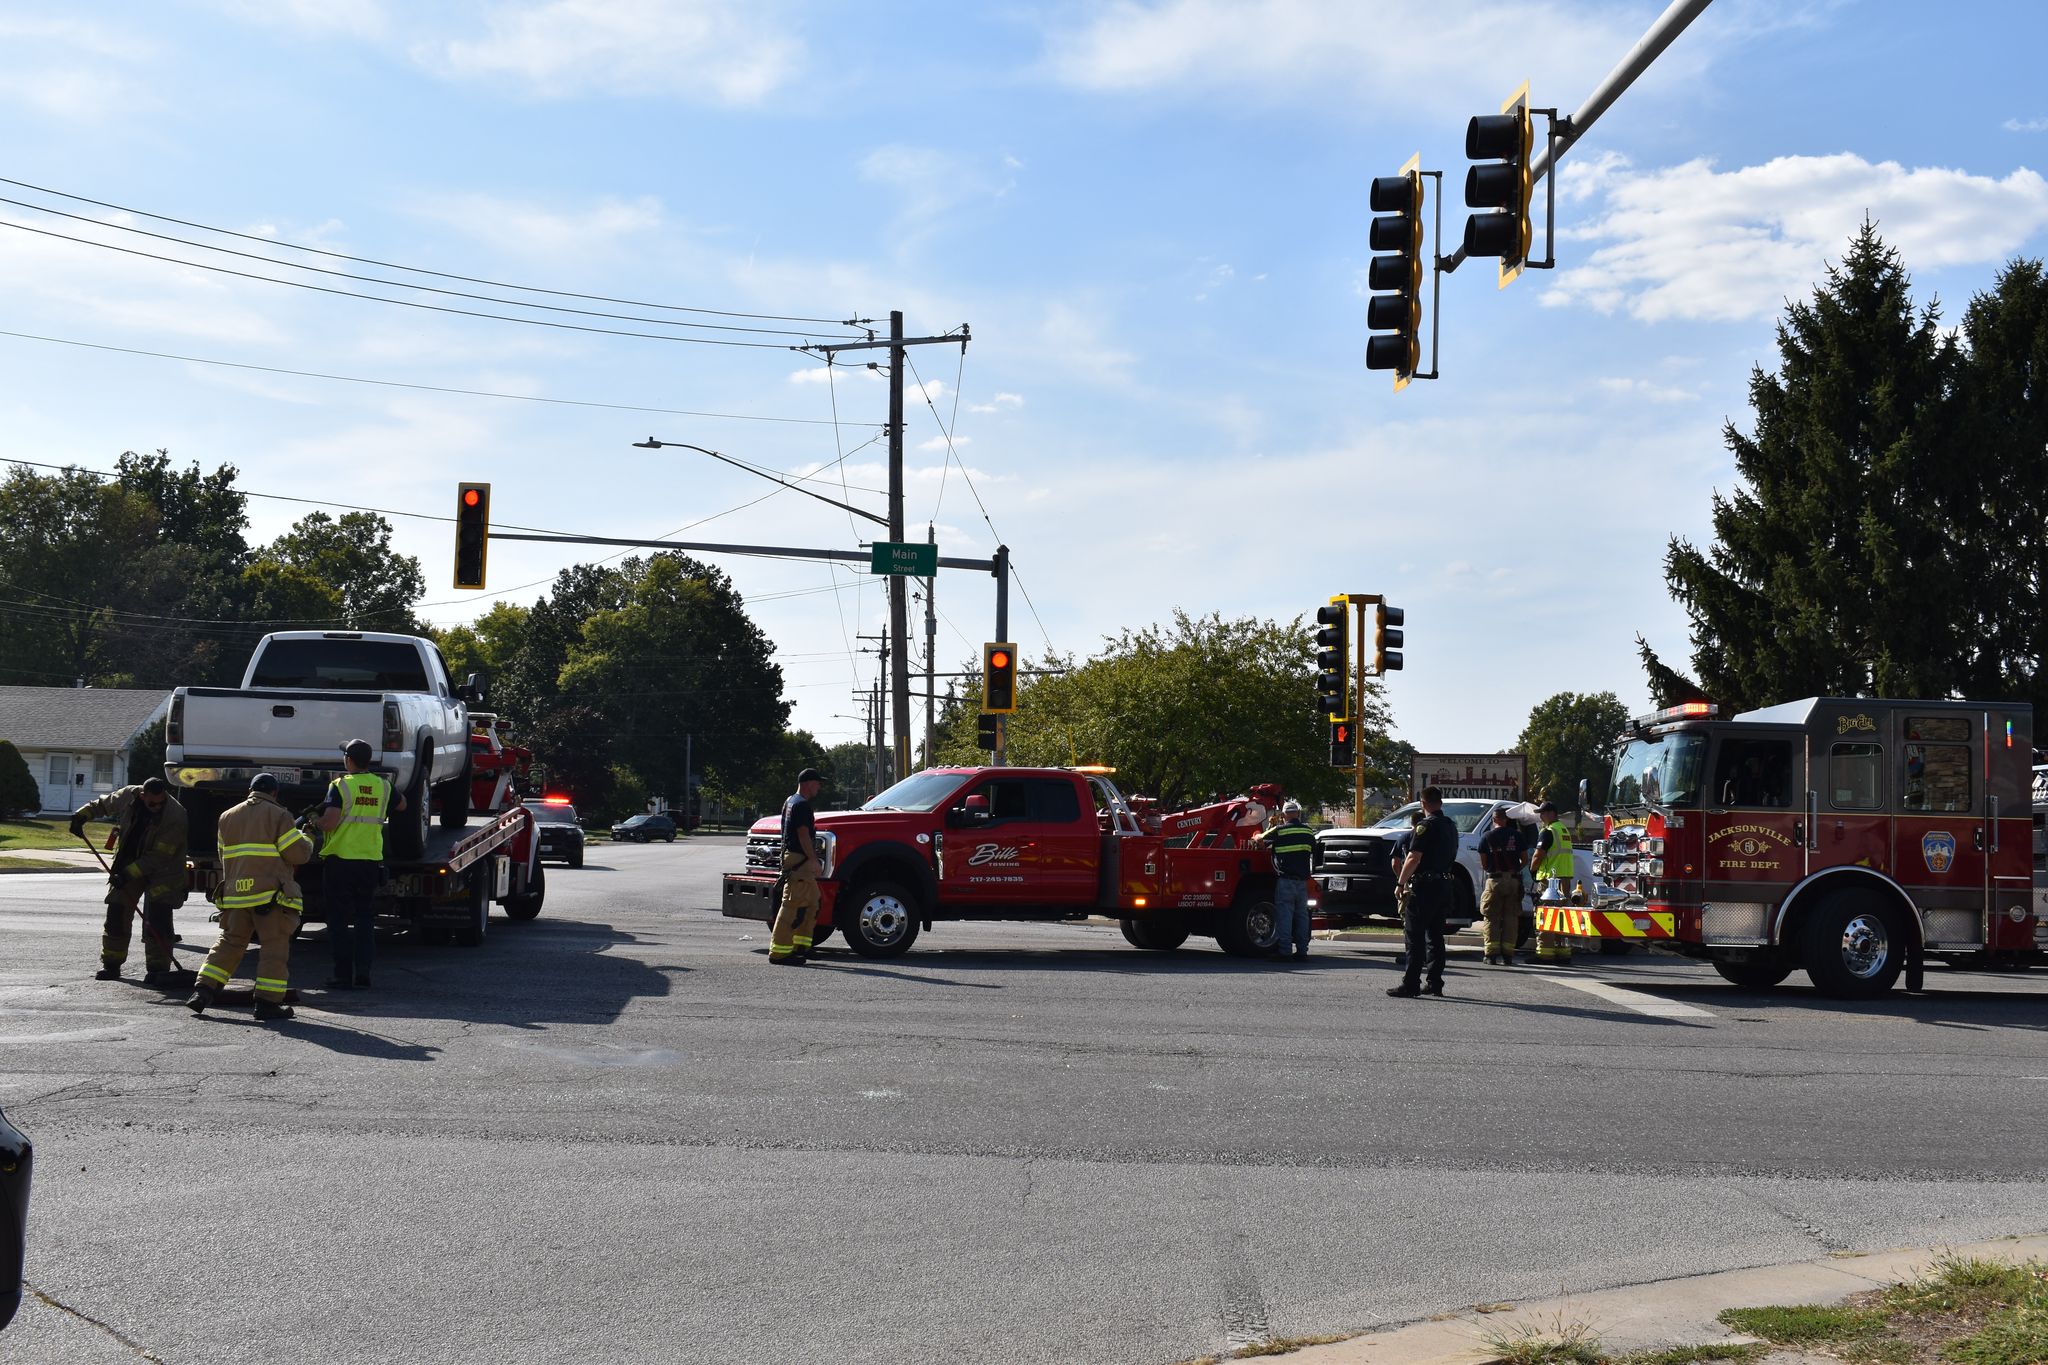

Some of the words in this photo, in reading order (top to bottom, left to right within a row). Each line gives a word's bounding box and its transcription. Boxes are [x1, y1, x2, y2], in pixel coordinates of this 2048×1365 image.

[892, 548, 917, 560] Main
[893, 564, 915, 573] Street
[359, 785, 373, 795] FIRE
[355, 796, 379, 807] RESCUE
[1177, 816, 1202, 829] CENTURY
[1708, 824, 1792, 846] JACKSONVILLE
[968, 843, 1020, 866] Bills
[1720, 860, 1746, 868] FIRE
[235, 878, 255, 892] COOP
